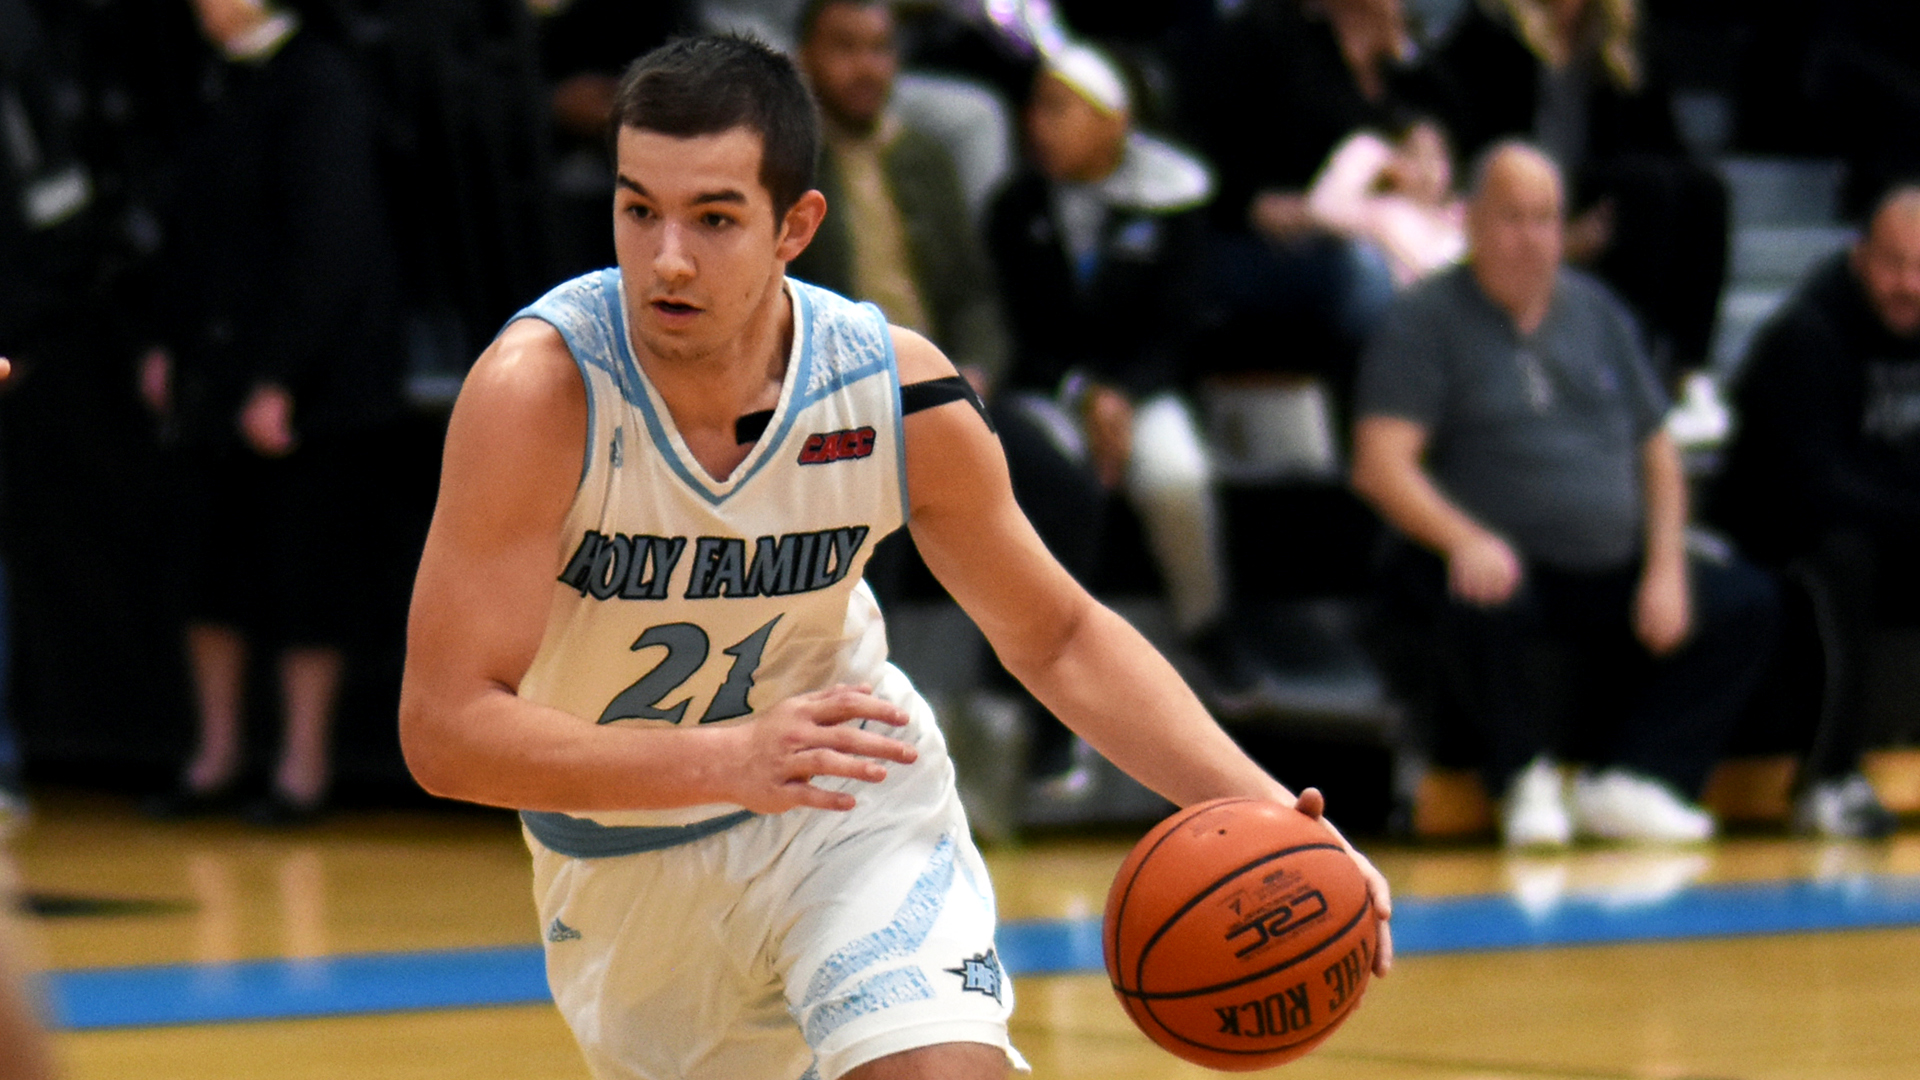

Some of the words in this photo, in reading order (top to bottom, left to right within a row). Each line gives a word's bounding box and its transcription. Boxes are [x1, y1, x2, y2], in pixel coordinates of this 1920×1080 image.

[797, 426, 877, 466] CACC
[557, 530, 687, 600] HOLY
[684, 525, 870, 598] FAMILY
[595, 612, 786, 726] 21
[1213, 981, 1313, 1038] ROCK
